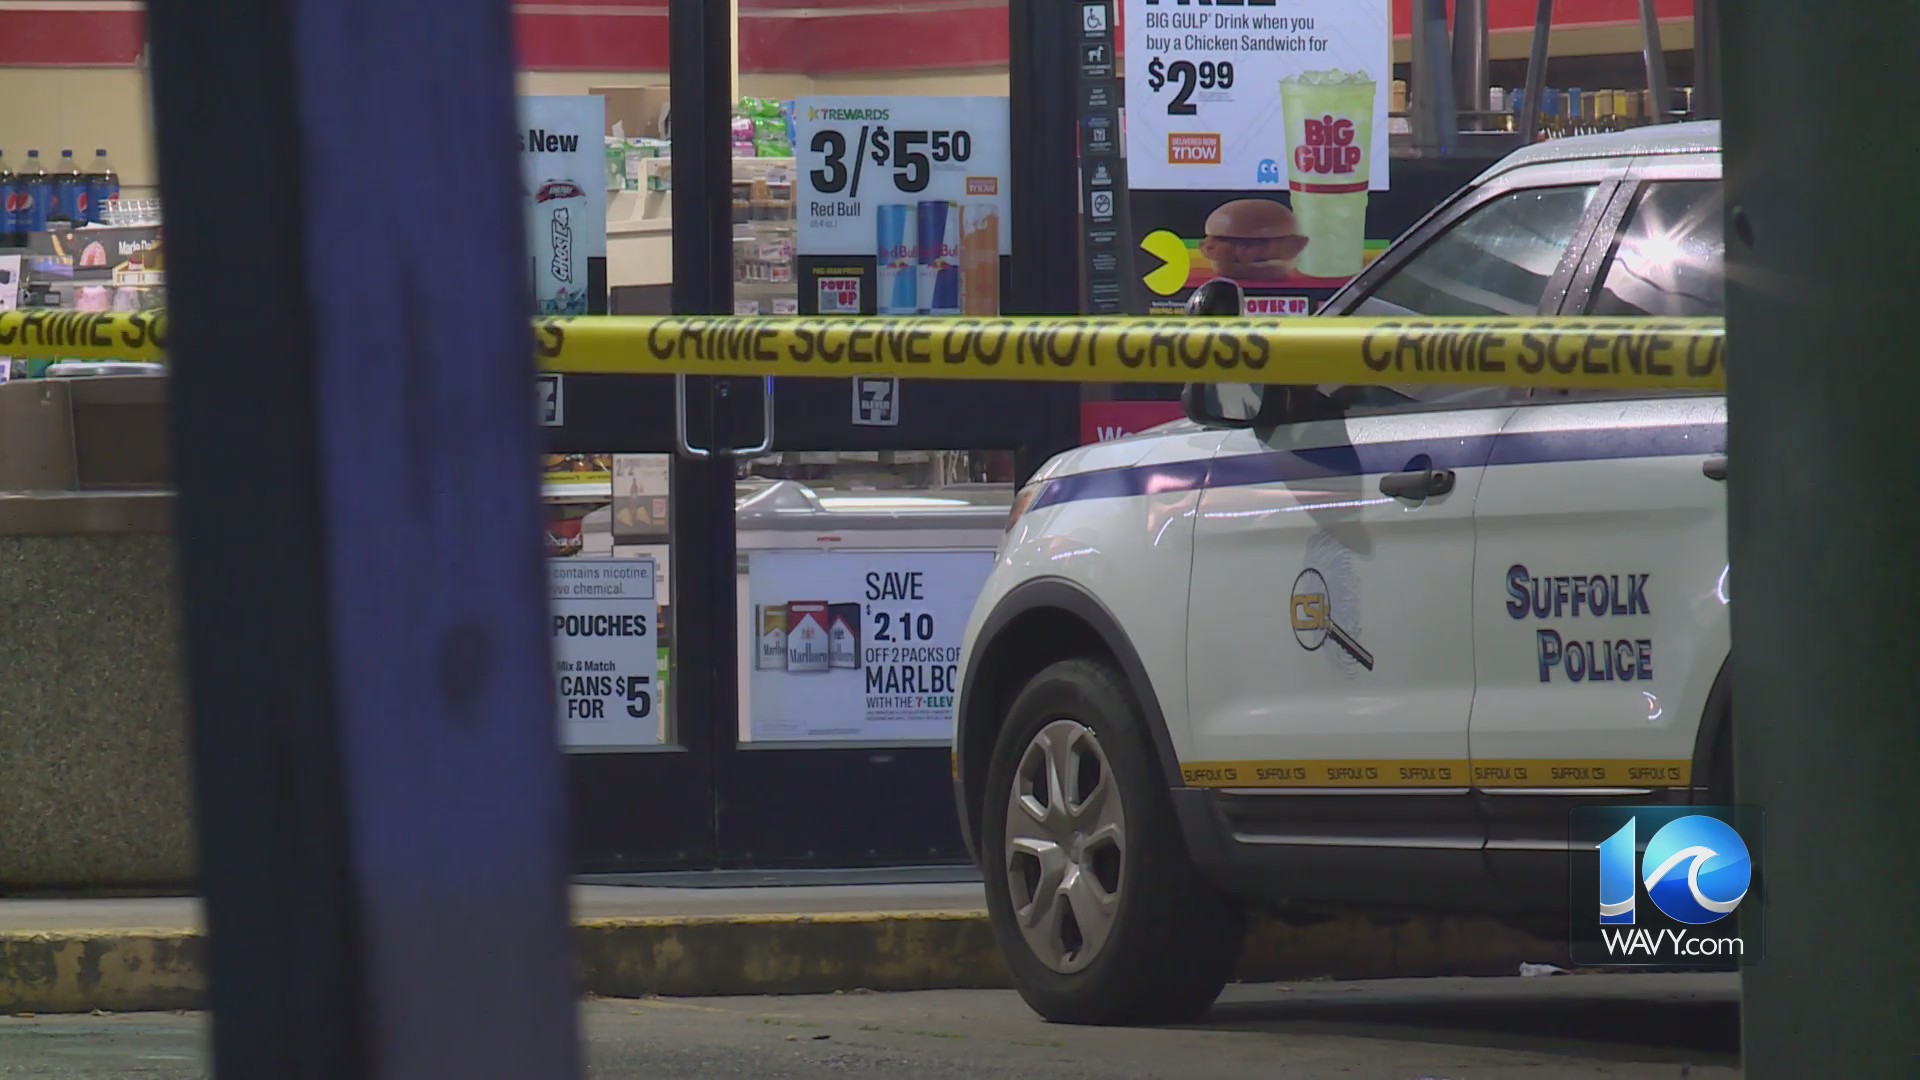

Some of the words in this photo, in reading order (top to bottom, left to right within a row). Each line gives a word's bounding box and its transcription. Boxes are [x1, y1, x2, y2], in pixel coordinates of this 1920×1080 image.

[1146, 12, 1169, 28] BIG
[1215, 13, 1250, 29] Drink
[1252, 14, 1288, 30] when
[1291, 17, 1314, 33] you
[1146, 34, 1171, 54] buy
[1173, 38, 1182, 51] a
[1184, 34, 1238, 51] Chicken
[1241, 35, 1306, 52] Sandwich
[1309, 35, 1329, 52] for
[528, 129, 579, 153] New
[1294, 146, 1361, 174] GULP
[810, 202, 834, 217] Red
[837, 202, 861, 217] Bull
[821, 280, 857, 290] POWER
[838, 291, 857, 306] UP
[1246, 299, 1286, 314] OWER
[1289, 299, 1306, 314] UP
[648, 318, 785, 361] CRIME
[788, 318, 942, 364] SCENE
[943, 320, 1008, 366] DO
[1016, 321, 1119, 367] NOT
[1116, 321, 1279, 370] CROSS
[1361, 322, 1518, 373] CRIME
[1516, 323, 1686, 376] SCENE
[1687, 324, 1726, 377] D
[603, 566, 647, 579] nicotine
[865, 571, 924, 601] SAVE
[553, 615, 647, 637] POUCHES
[866, 647, 890, 663] OFF
[892, 647, 900, 663] 2
[902, 647, 944, 663] PACKS
[576, 661, 583, 672] &
[585, 660, 616, 672] Match
[560, 675, 612, 697] CANS
[568, 699, 604, 719] FOR
[867, 696, 892, 709] WITH
[894, 696, 912, 709] THE
[1185, 770, 1222, 782] SUFFOLK
[1257, 768, 1291, 781] SUFFOLK
[1328, 768, 1363, 780] SUFFOLK
[1400, 768, 1436, 780] SUFFOLK
[1475, 768, 1511, 780] SUFFOLK
[1552, 768, 1589, 780] SUFFOLK
[1629, 768, 1666, 780] SUFFOLK
